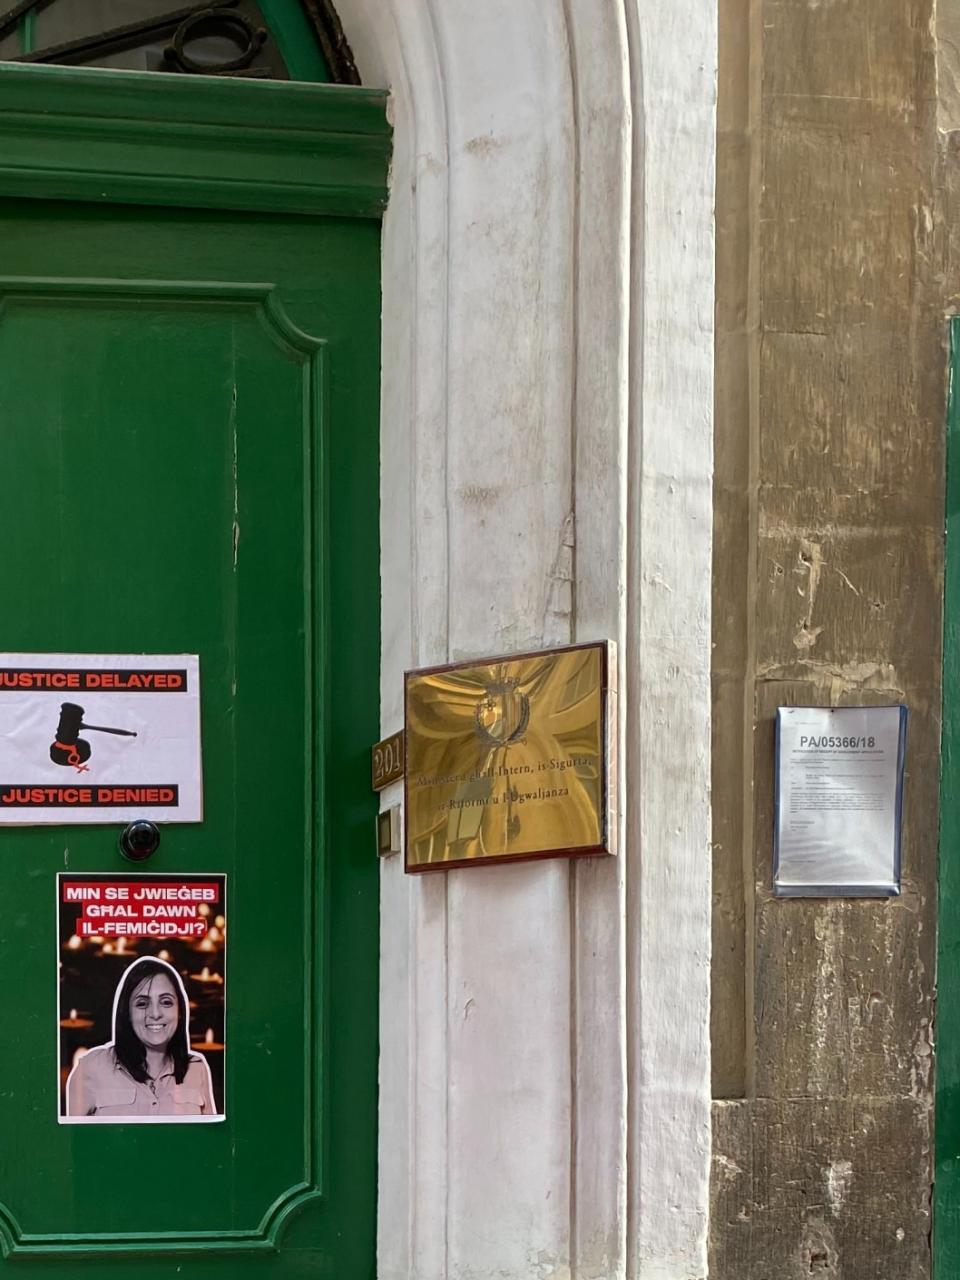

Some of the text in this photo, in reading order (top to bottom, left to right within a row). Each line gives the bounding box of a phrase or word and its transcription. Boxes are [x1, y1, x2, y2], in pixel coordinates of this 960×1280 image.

[86, 673, 182, 688] DELAYED
[800, 736, 876, 748] PA/05366/18
[374, 738, 401, 782] 201
[2, 788, 174, 803] JUSTICE DENIED
[66, 885, 216, 901] MIN SE JWIEĠEB
[143, 905, 197, 917] DAWN
[82, 920, 206, 935] IL-FEMIĊIDJI?
